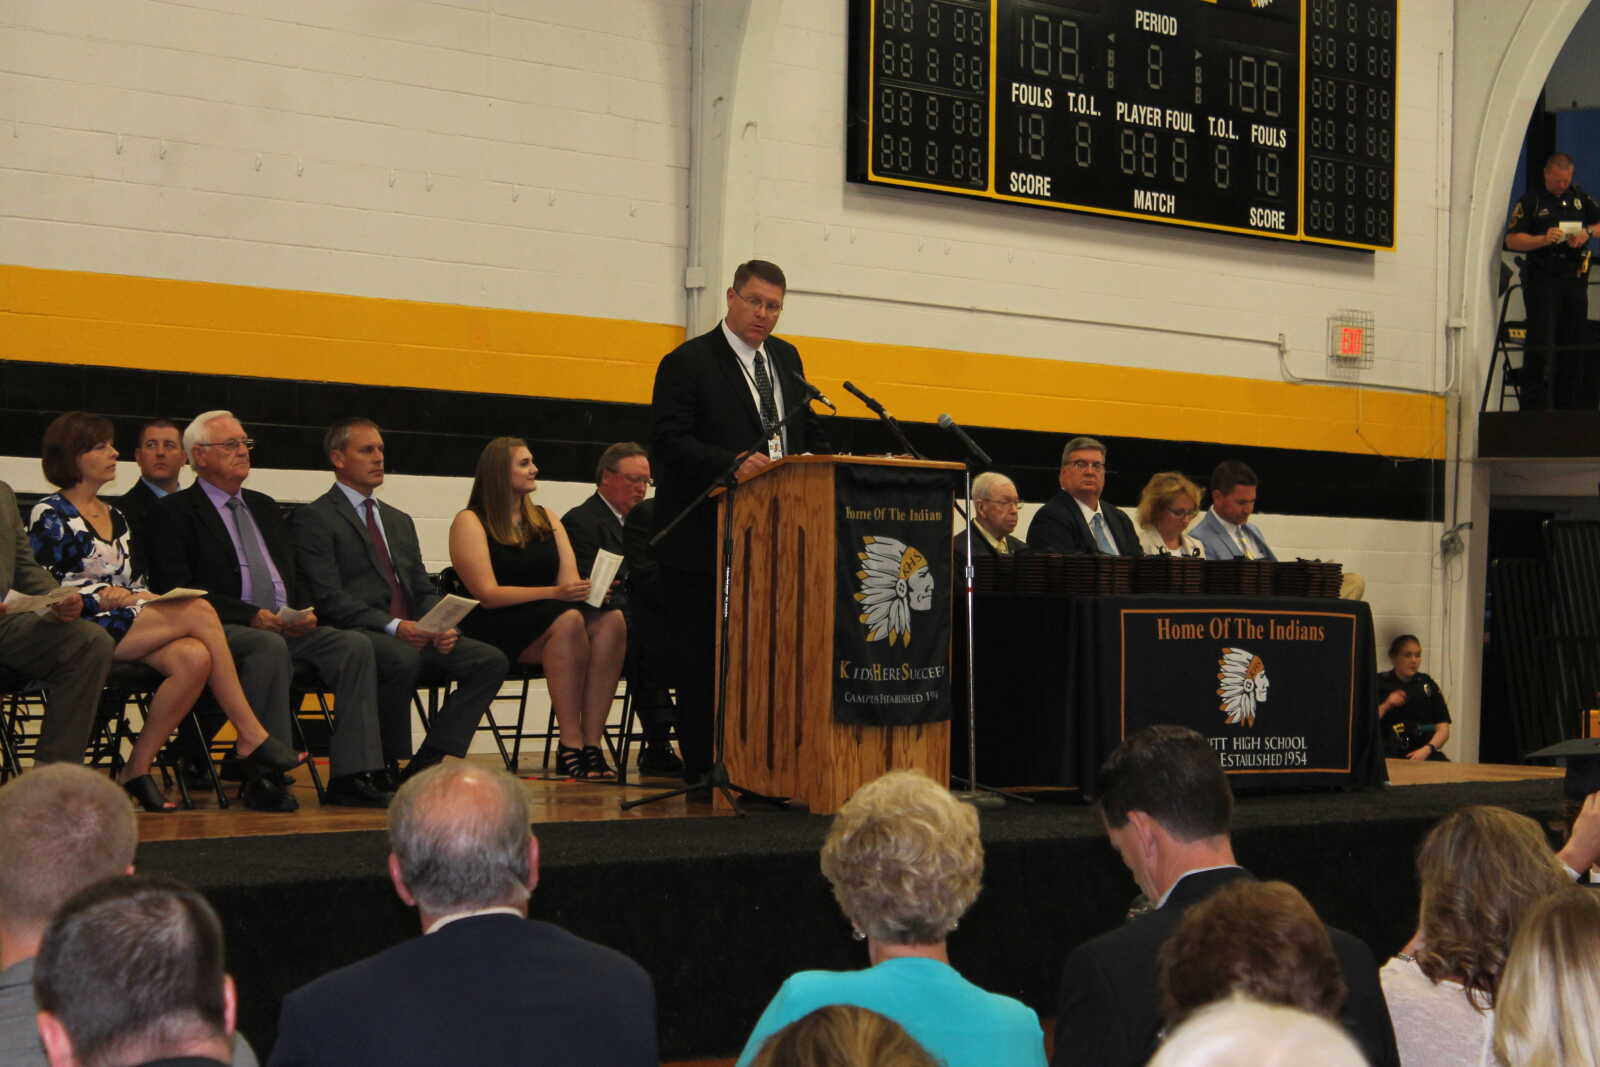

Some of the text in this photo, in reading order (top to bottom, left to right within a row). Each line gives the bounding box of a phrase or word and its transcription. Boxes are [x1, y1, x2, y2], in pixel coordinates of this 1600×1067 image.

[1135, 9, 1178, 37] PERIOD
[1011, 82, 1053, 109] FOULS
[1067, 92, 1101, 117] T.O.L.
[1116, 101, 1196, 133] PLAYER FOUL
[1208, 116, 1239, 140] T.O.L.
[1251, 124, 1287, 148] FOULS
[1009, 171, 1051, 197] SCORE
[1133, 189, 1175, 214] MATCH
[1250, 207, 1286, 230] SCORE
[874, 507, 886, 520] Of
[1157, 616, 1326, 642] Home Of The Indians
[1233, 736, 1261, 750] HIGH
[1264, 736, 1308, 750] SCHOOL
[1283, 751, 1308, 766] 1954
